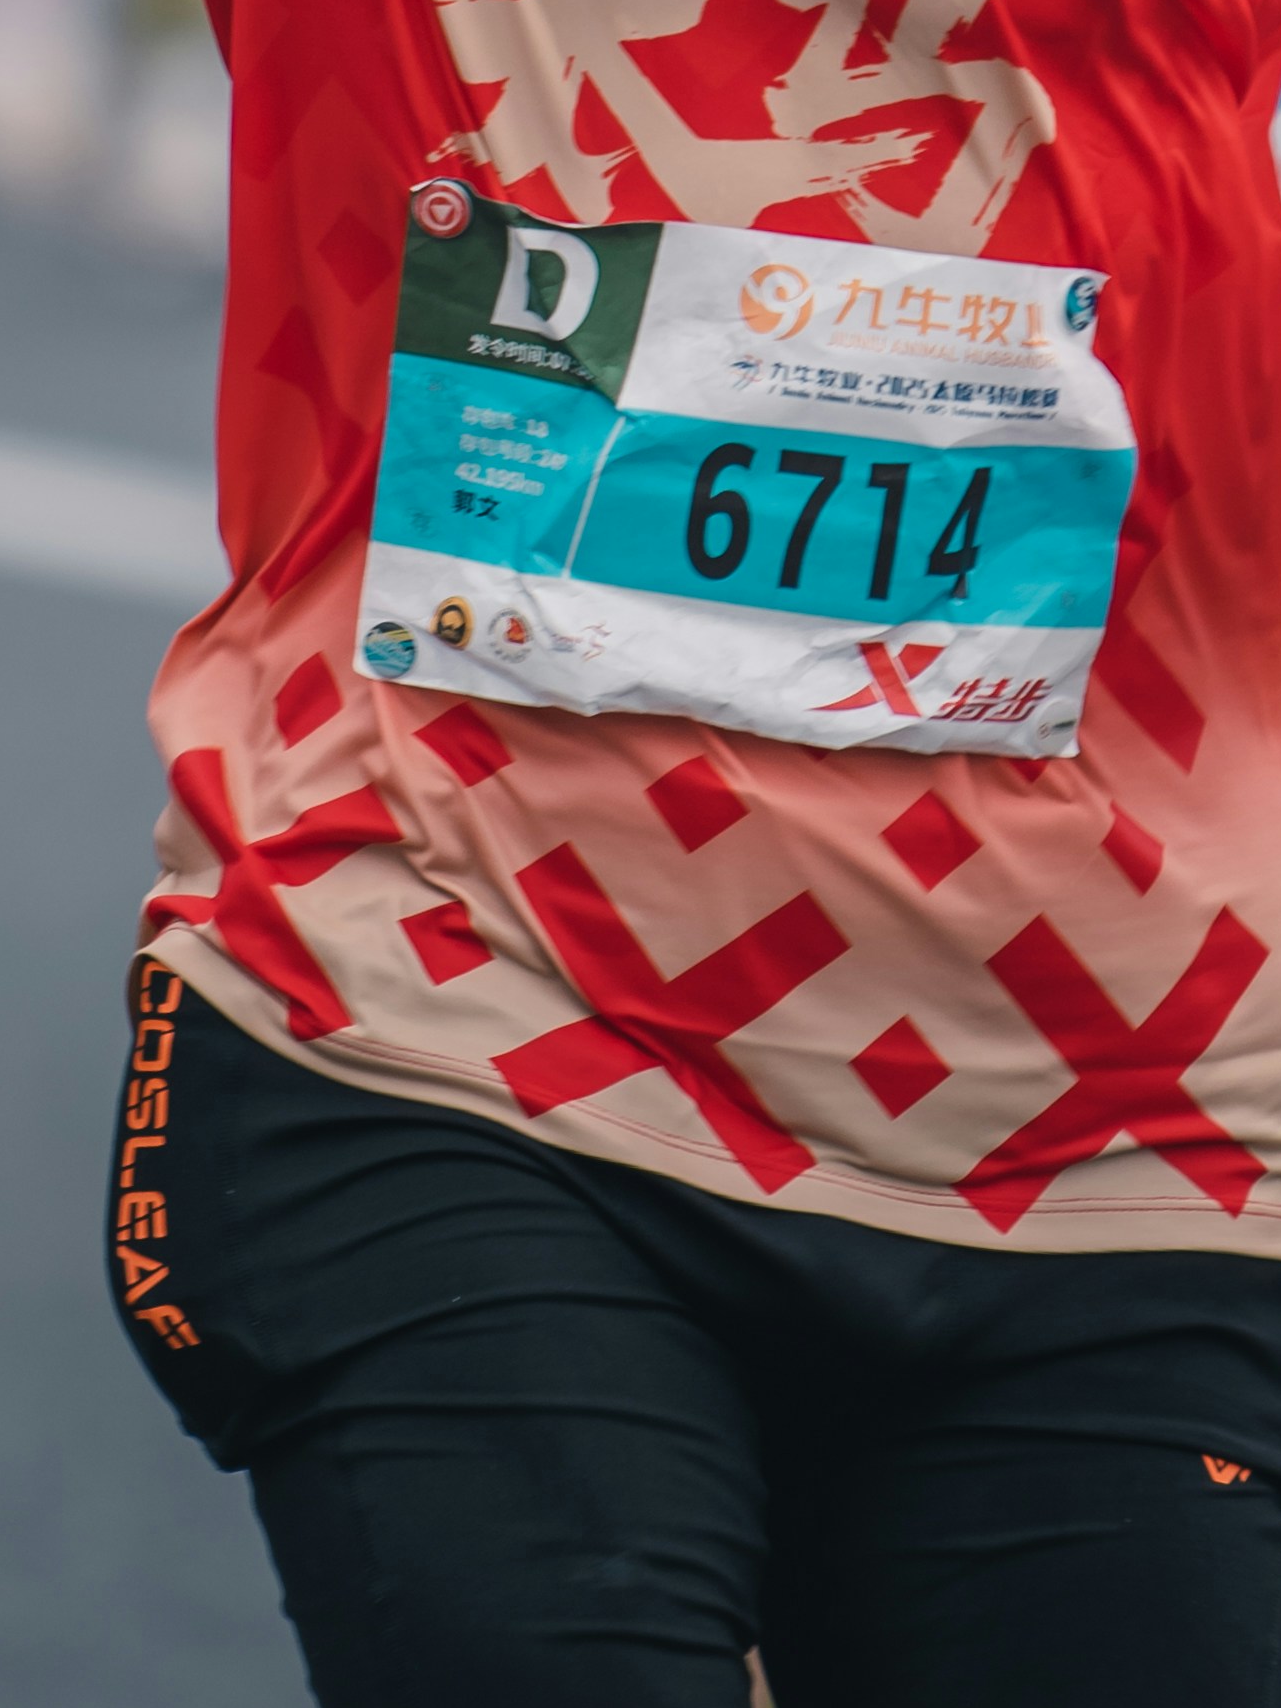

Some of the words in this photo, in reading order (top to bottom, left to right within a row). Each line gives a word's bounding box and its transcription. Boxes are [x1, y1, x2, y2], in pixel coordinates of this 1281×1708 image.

[490, 226, 600, 341] D
[686, 442, 994, 600] 6714
[116, 960, 201, 1350] COSLEAF
